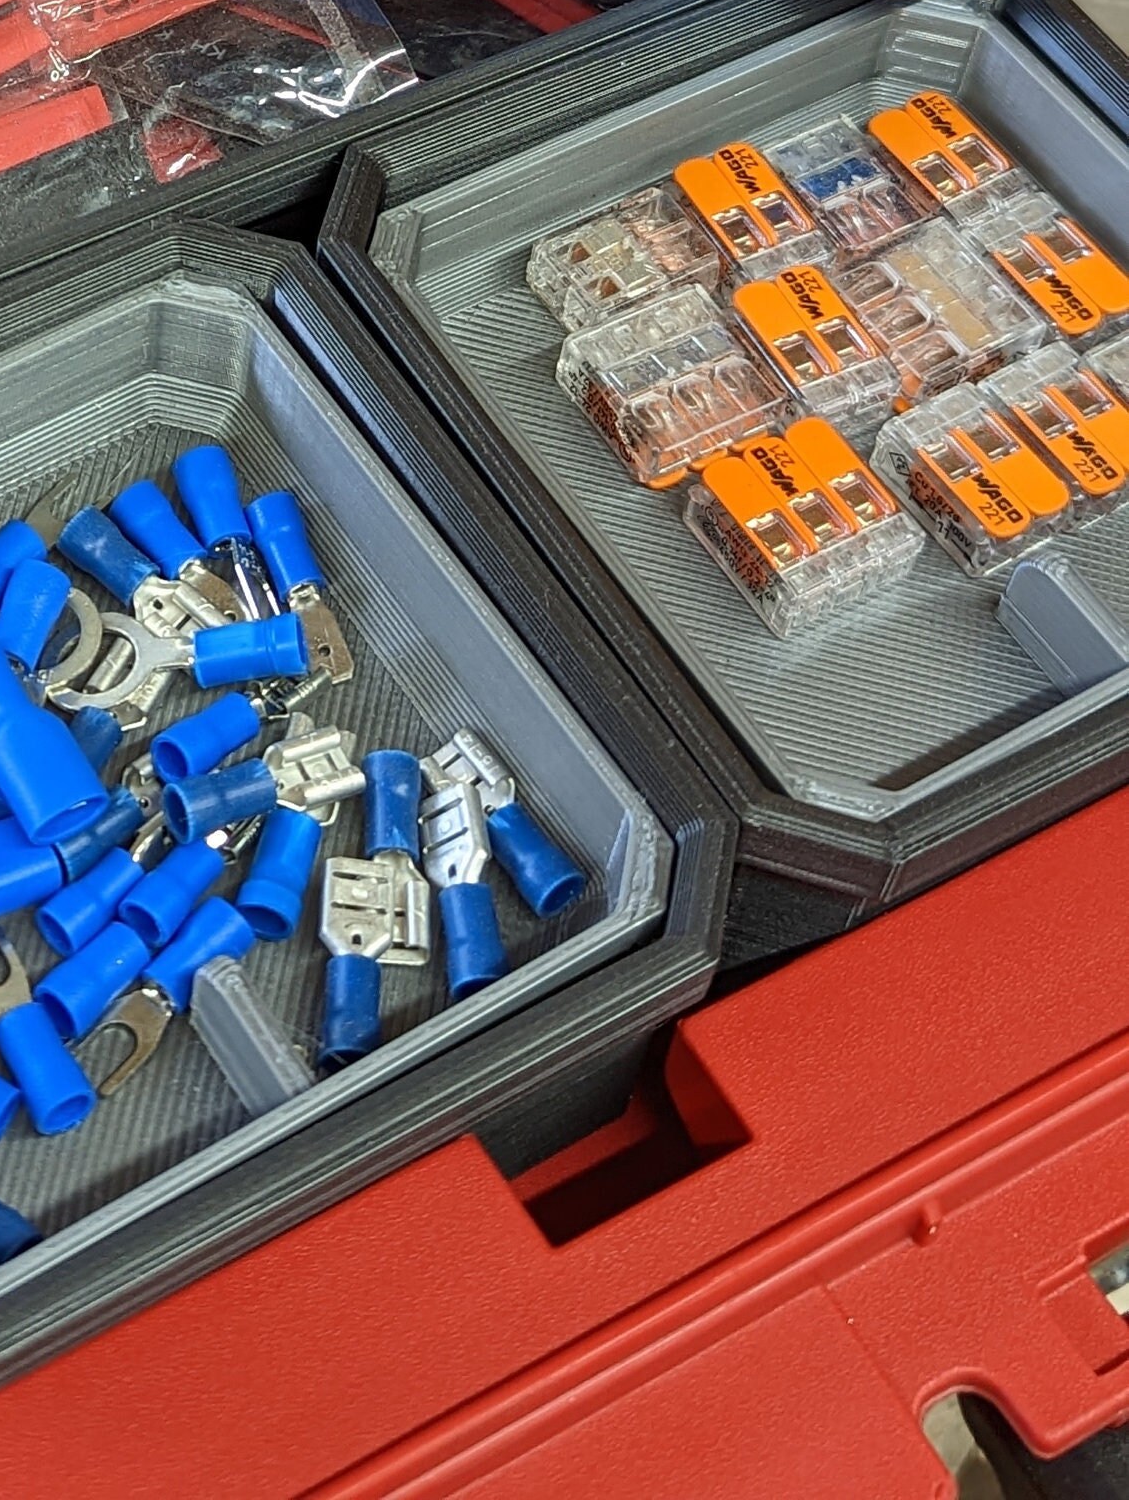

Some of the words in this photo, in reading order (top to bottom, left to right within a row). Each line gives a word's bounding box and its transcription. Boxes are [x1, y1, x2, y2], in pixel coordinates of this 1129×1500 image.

[910, 97, 957, 139] WAGO
[926, 95, 952, 115] 221
[718, 148, 761, 194] WAGO
[734, 148, 759, 169] 221
[780, 271, 824, 320] WAGO
[798, 271, 823, 293] 221
[1044, 274, 1093, 320] WAGO
[1051, 301, 1076, 323] 221
[750, 446, 799, 497] WAGO
[770, 444, 796, 468] 221
[1066, 430, 1118, 480] WAGO
[1073, 459, 1100, 483] 221
[971, 472, 1023, 524] WAGO
[978, 502, 1005, 527] 221
